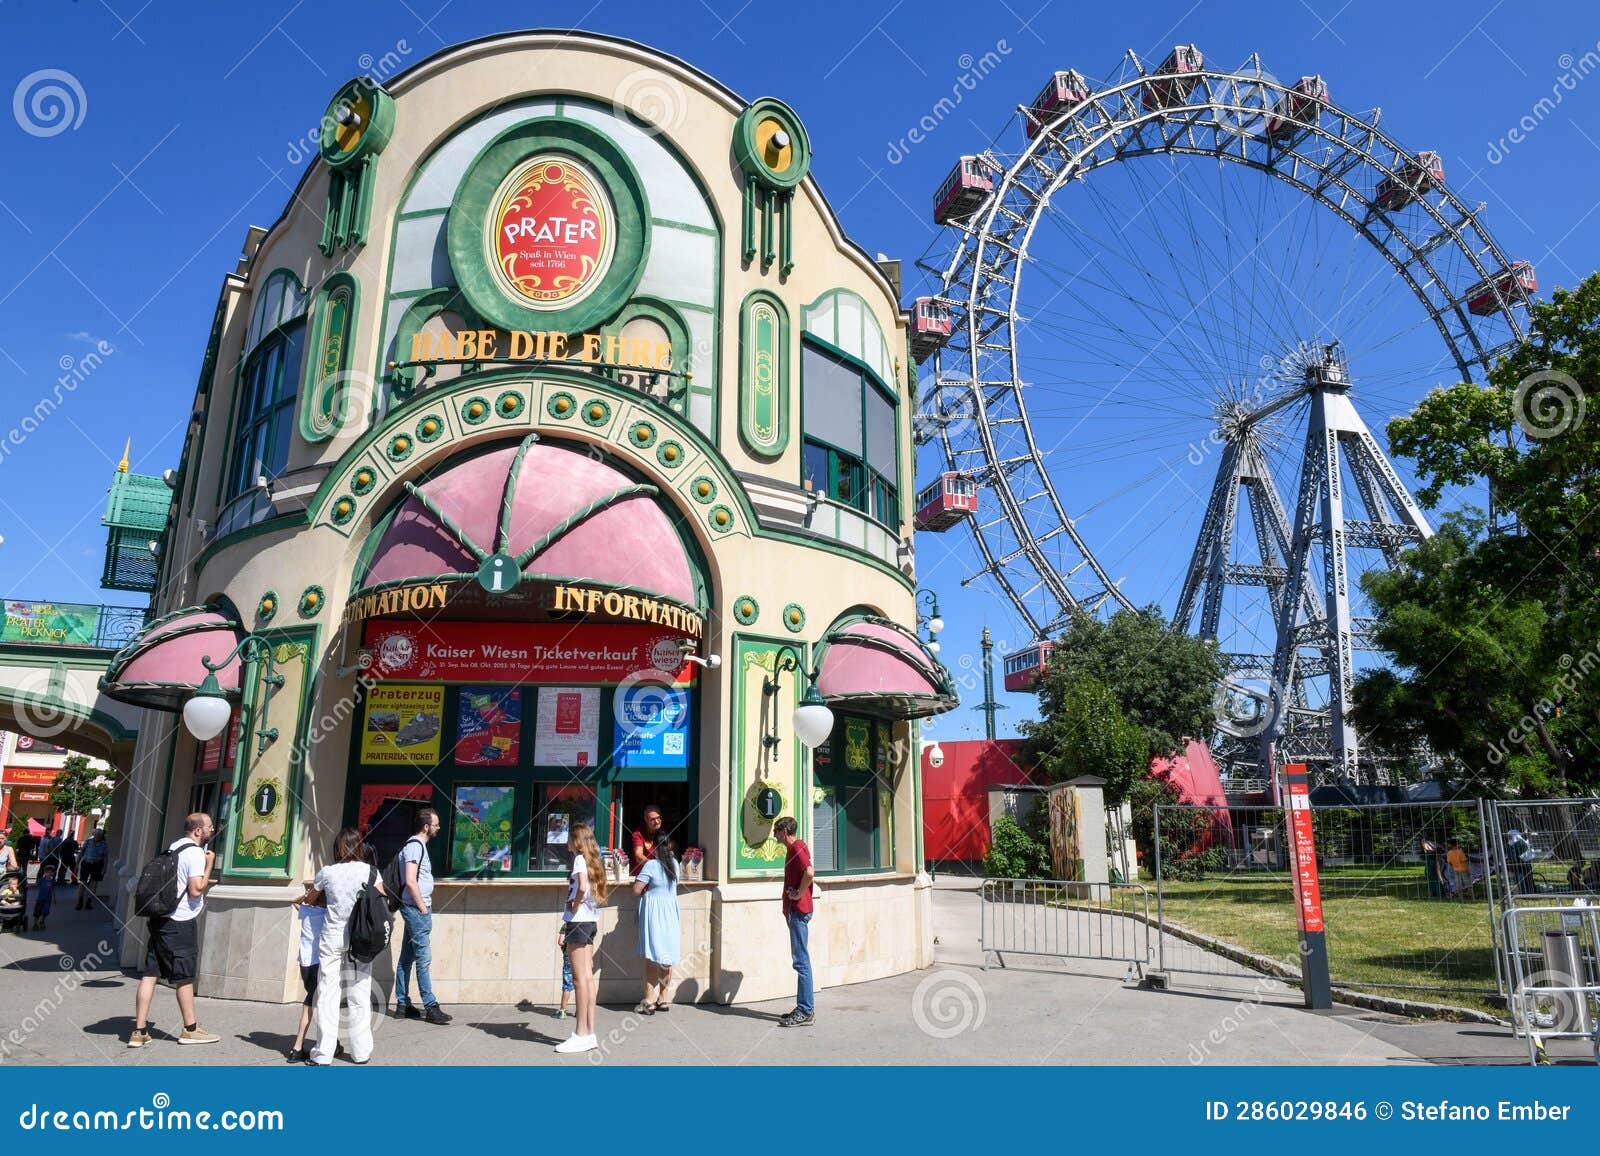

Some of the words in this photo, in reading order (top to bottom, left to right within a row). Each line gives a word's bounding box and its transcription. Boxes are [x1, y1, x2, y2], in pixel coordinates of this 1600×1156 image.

[504, 216, 596, 244] PRATER
[520, 250, 542, 260] Spaß
[543, 250, 552, 258] in
[554, 250, 577, 260] Wien
[529, 260, 545, 268] seit
[547, 260, 566, 269] 1766
[410, 330, 497, 361] HABE
[507, 330, 569, 361] DIE
[582, 333, 672, 370] EHRE
[490, 558, 505, 591] i
[554, 585, 703, 639] INFORMATION
[6, 616, 45, 627] PRATER
[21, 627, 68, 638] PICKNICK
[426, 643, 475, 659] Kaiser
[481, 644, 528, 660] Wiesn
[534, 645, 639, 661] Ticketverkauf
[370, 688, 441, 703] Praterzug
[369, 703, 388, 711] prater
[366, 752, 408, 761] PRATERZUG
[409, 752, 434, 761] TICKET
